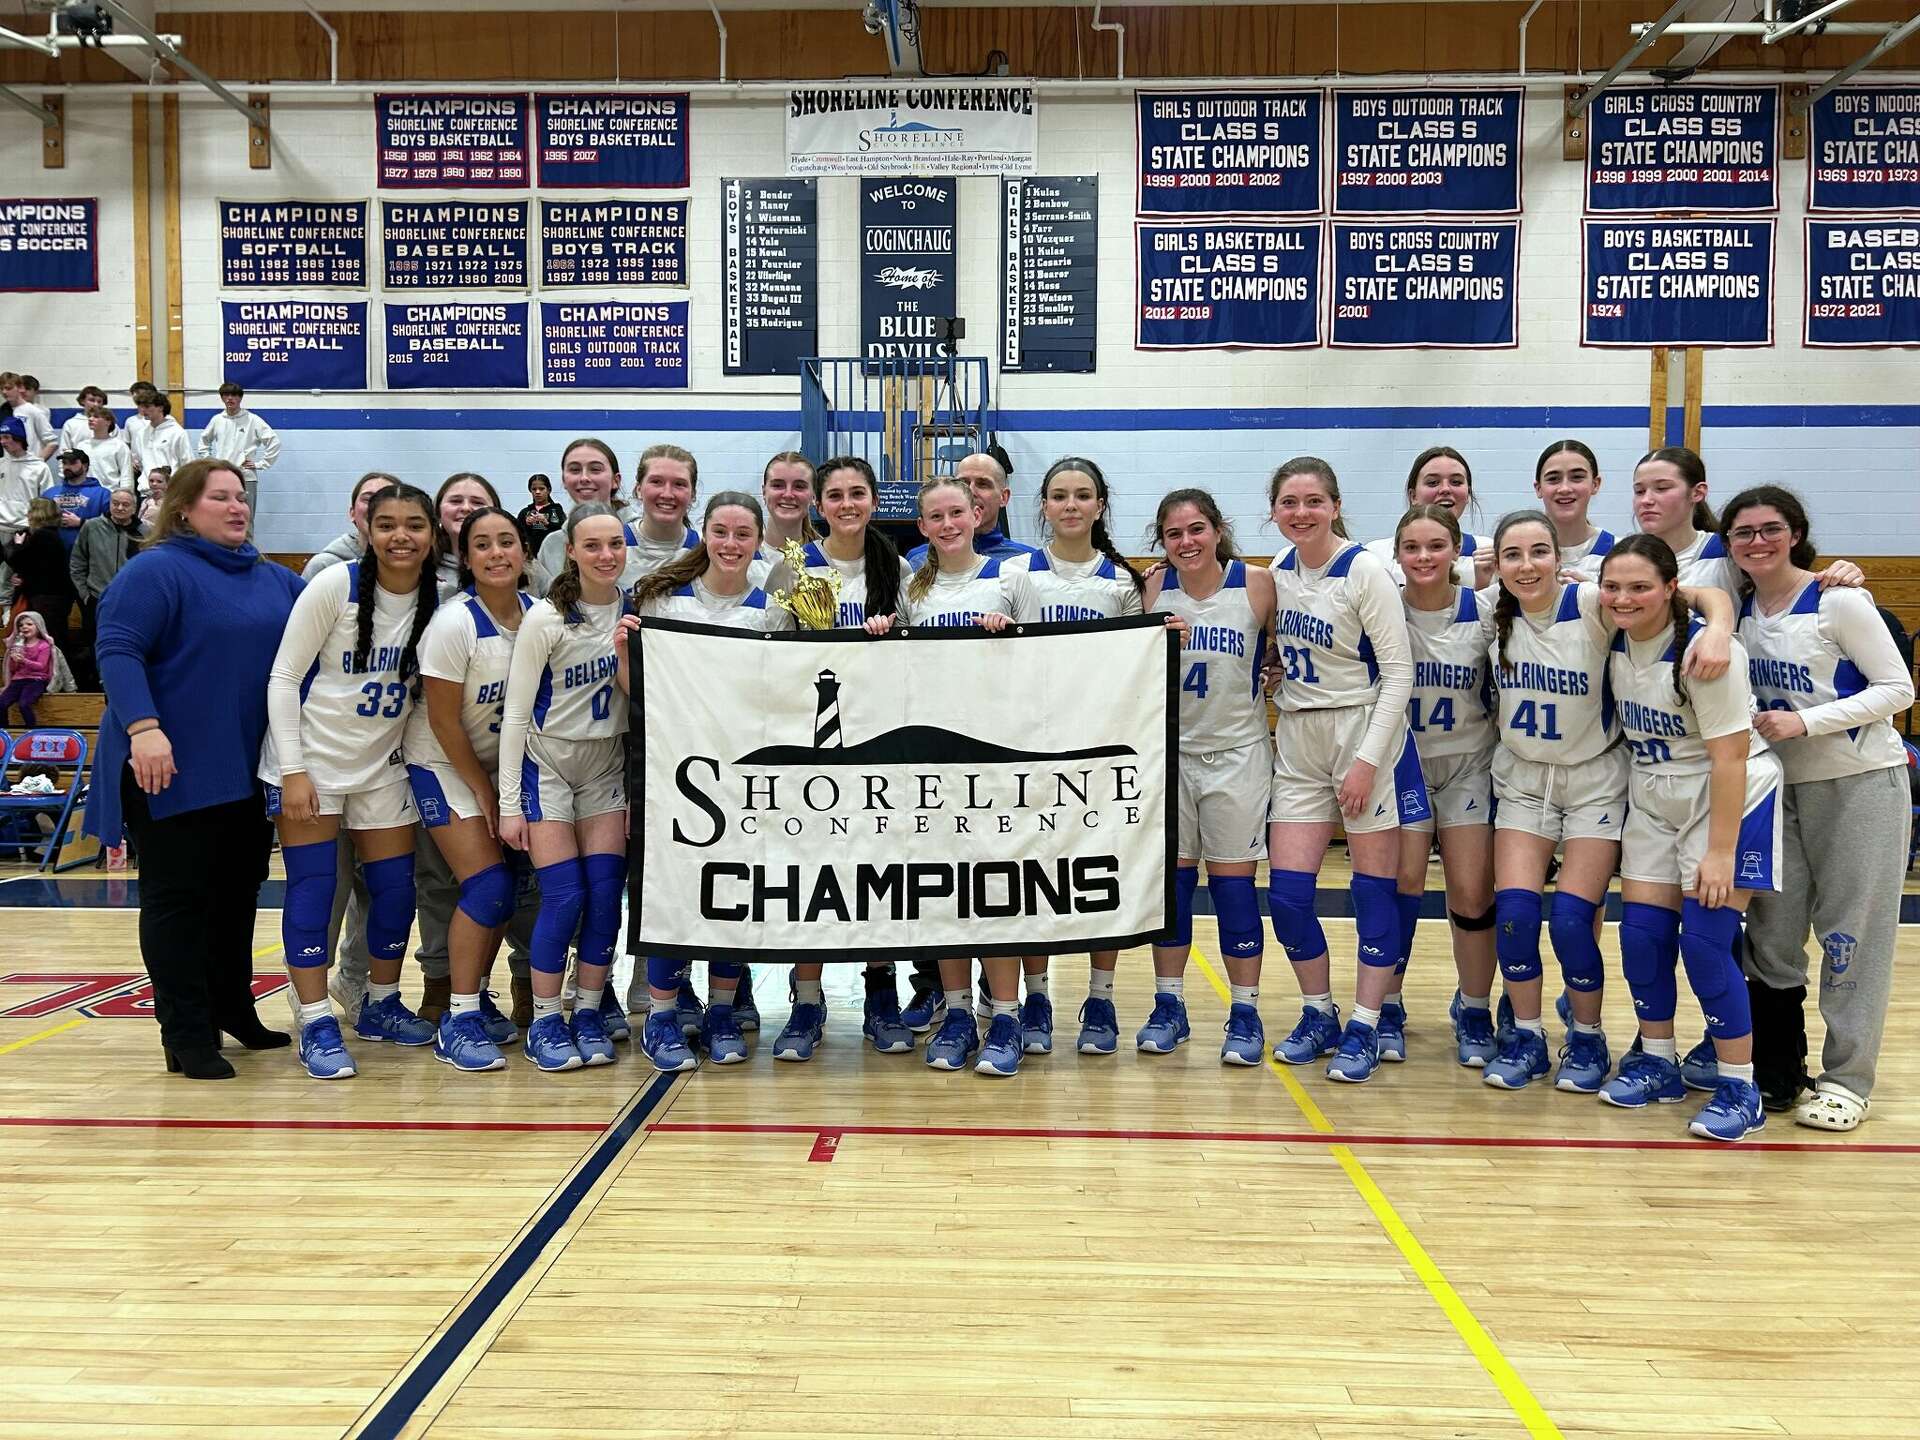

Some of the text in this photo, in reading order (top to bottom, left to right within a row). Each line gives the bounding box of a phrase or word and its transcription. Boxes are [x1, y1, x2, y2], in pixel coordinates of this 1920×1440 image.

[389, 100, 515, 115] CHAMPIONS
[550, 100, 675, 115] CHAMPIONS
[791, 88, 1032, 118] SHORELINE CONFERENCE
[1153, 100, 1307, 118] GIRLS OUTDOOR TRACK
[1353, 98, 1503, 116] BOYS OUTDOOR TRACK
[1605, 95, 1761, 114] GIRLS CROSS COUNTRY
[1835, 96, 1869, 113] BOYS
[388, 119, 517, 130] SHORELINE CONFERENCE
[1182, 123, 1278, 140] CLASS S
[1378, 121, 1477, 139] CLASS S
[1625, 118, 1741, 136] CLASS SS
[392, 134, 513, 146] BOYS BASKETBALL
[550, 134, 675, 146] BOYS BASKETBALL
[859, 130, 964, 151] SHORELINE
[545, 152, 596, 160] 1995 2007
[1152, 145, 1309, 169] STATE CHAMPIONS
[1348, 144, 1506, 168] STATE CHAMPIONS
[1602, 141, 1763, 165] STATE CHAMPIONS
[1824, 141, 1878, 164] STATE
[1146, 174, 1280, 187] 1999 2000 2001 2002
[1341, 172, 1441, 185] 1997 2000 2003
[1595, 169, 1769, 183] 1998 1999 2000 2001 2014
[1818, 169, 1917, 181] 1969 1970 1973
[870, 184, 947, 203] WELCOME
[1026, 188, 1030, 196] 1
[901, 201, 915, 210] TO
[229, 208, 357, 223] CHAMPIONS
[745, 214, 801, 222] 4 Wiseman
[1025, 213, 1030, 221] 3
[21, 223, 87, 235] CONFERENCE
[1024, 224, 1030, 232] 4
[17, 238, 87, 250] SOCCER
[867, 229, 951, 251] COGINCHAUG
[1023, 235, 1074, 244] 10 Vazquez
[1155, 232, 1304, 251] GIRLS BASKETBALL
[1350, 232, 1499, 250] BOYS CROSS COUNTRY
[1604, 229, 1753, 248] BOYS BASKETBALL
[242, 244, 346, 255] SOFTBALL
[397, 245, 514, 256] BASEBALL
[552, 243, 675, 255] BOYS TRACK
[746, 248, 756, 256] 15
[426, 261, 522, 270] 1971 1972 1975
[745, 260, 802, 268] 21 Fournier
[228, 272, 359, 281] 1990 1995 1999 2002
[728, 189, 739, 363] BOYS BASKETBALL
[881, 268, 936, 288] Home of
[1008, 185, 1018, 360] GIRLS BASKETBALL
[1151, 277, 1307, 301] STATE CHAMPIONS
[1597, 275, 1759, 299] STATE CHAMPIONS
[1024, 293, 1073, 302] 22 Watson
[241, 305, 348, 319] CHAMPIONS
[745, 307, 758, 315] 34
[897, 302, 918, 311] THE
[1145, 307, 1210, 319] 2012 2018
[1339, 306, 1368, 318] 2001
[1592, 305, 1621, 317] 1974
[1815, 304, 1881, 317] 1972 2021
[407, 307, 506, 321] CHAMPIONS
[560, 307, 669, 321] CHAMPIONS
[1024, 317, 1036, 325] 33
[747, 319, 802, 328] 35 Rodrigue
[880, 317, 936, 338] BLUE
[247, 338, 343, 349] SOFTBALL
[409, 338, 504, 350] BASEBALL
[550, 342, 680, 354] GIRLS OUTDOOR TRACK
[226, 352, 288, 362] 2007 2012
[389, 353, 449, 363] 2015 2021
[868, 343, 948, 365] DEVILS
[548, 358, 682, 368] 1999 2000 2001 2002
[548, 373, 575, 382] 2015
[1283, 646, 1319, 683] 31
[1183, 662, 1208, 698] 4
[357, 682, 407, 718] 33
[592, 685, 613, 720] 0
[1409, 697, 1455, 732] 14
[1510, 700, 1562, 740] 41
[672, 755, 1142, 848] SHORELINE
[741, 806, 1140, 837] CONFERENCE
[700, 854, 1120, 923] CHAMPIONS
